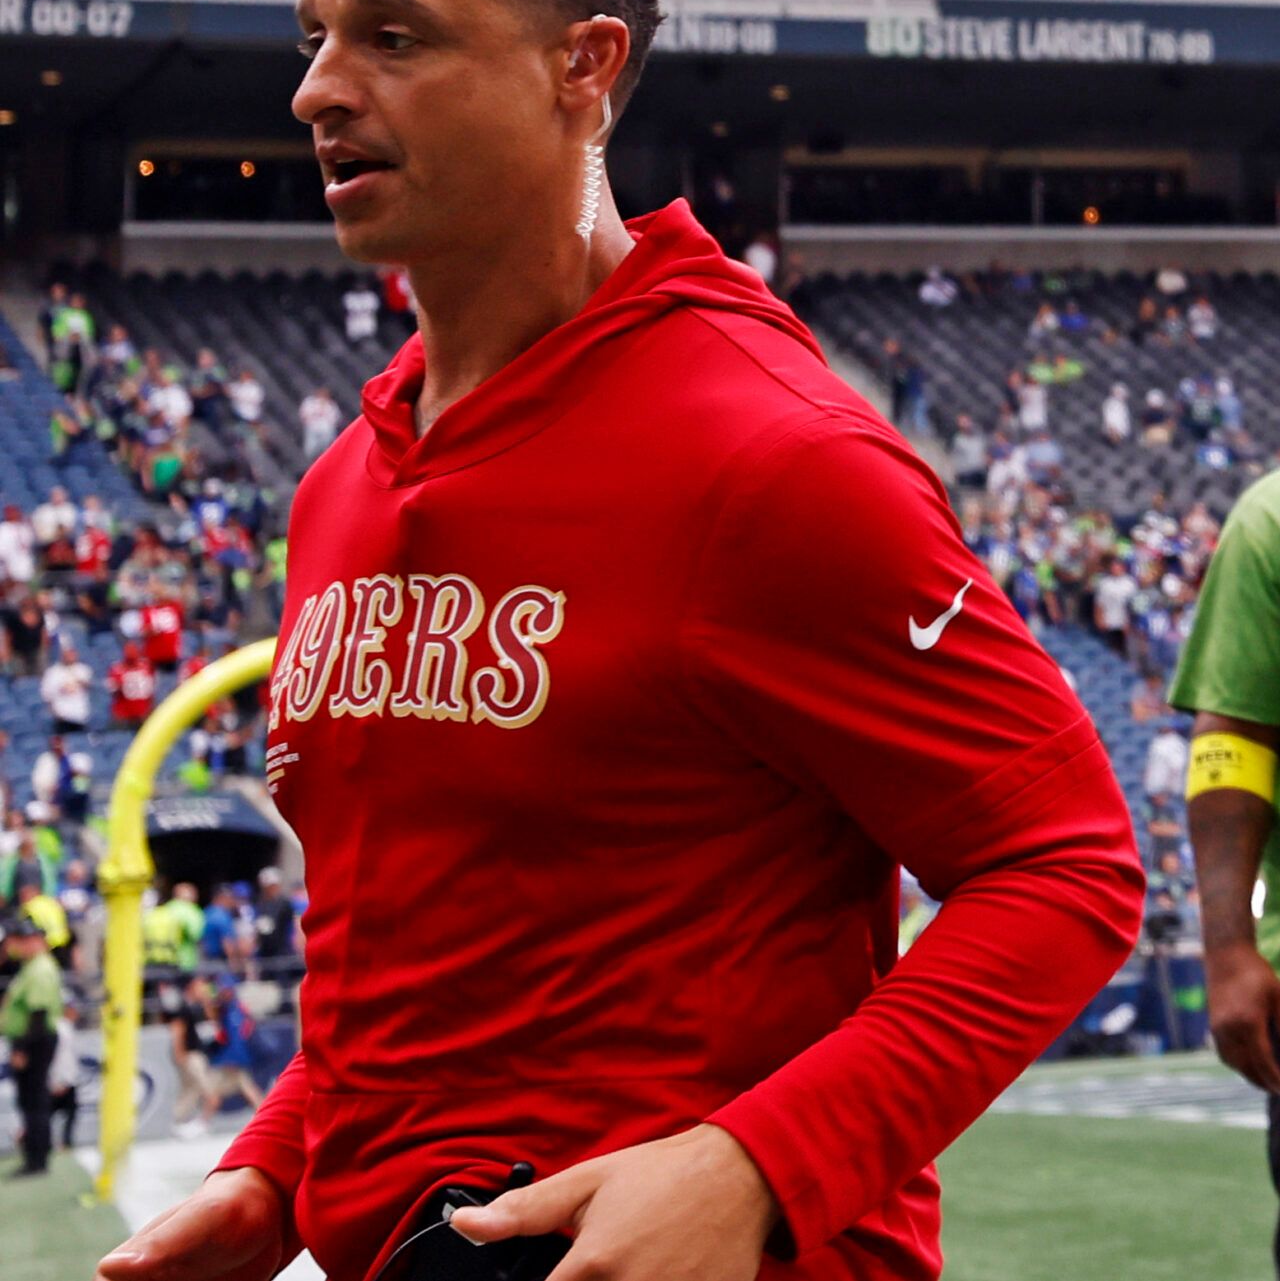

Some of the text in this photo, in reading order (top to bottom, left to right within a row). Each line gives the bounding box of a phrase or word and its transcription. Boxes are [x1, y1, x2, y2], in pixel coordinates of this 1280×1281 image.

[924, 19, 1012, 59] STEVE
[1016, 20, 1145, 62] LARGENT
[267, 572, 567, 730] 49ERS
